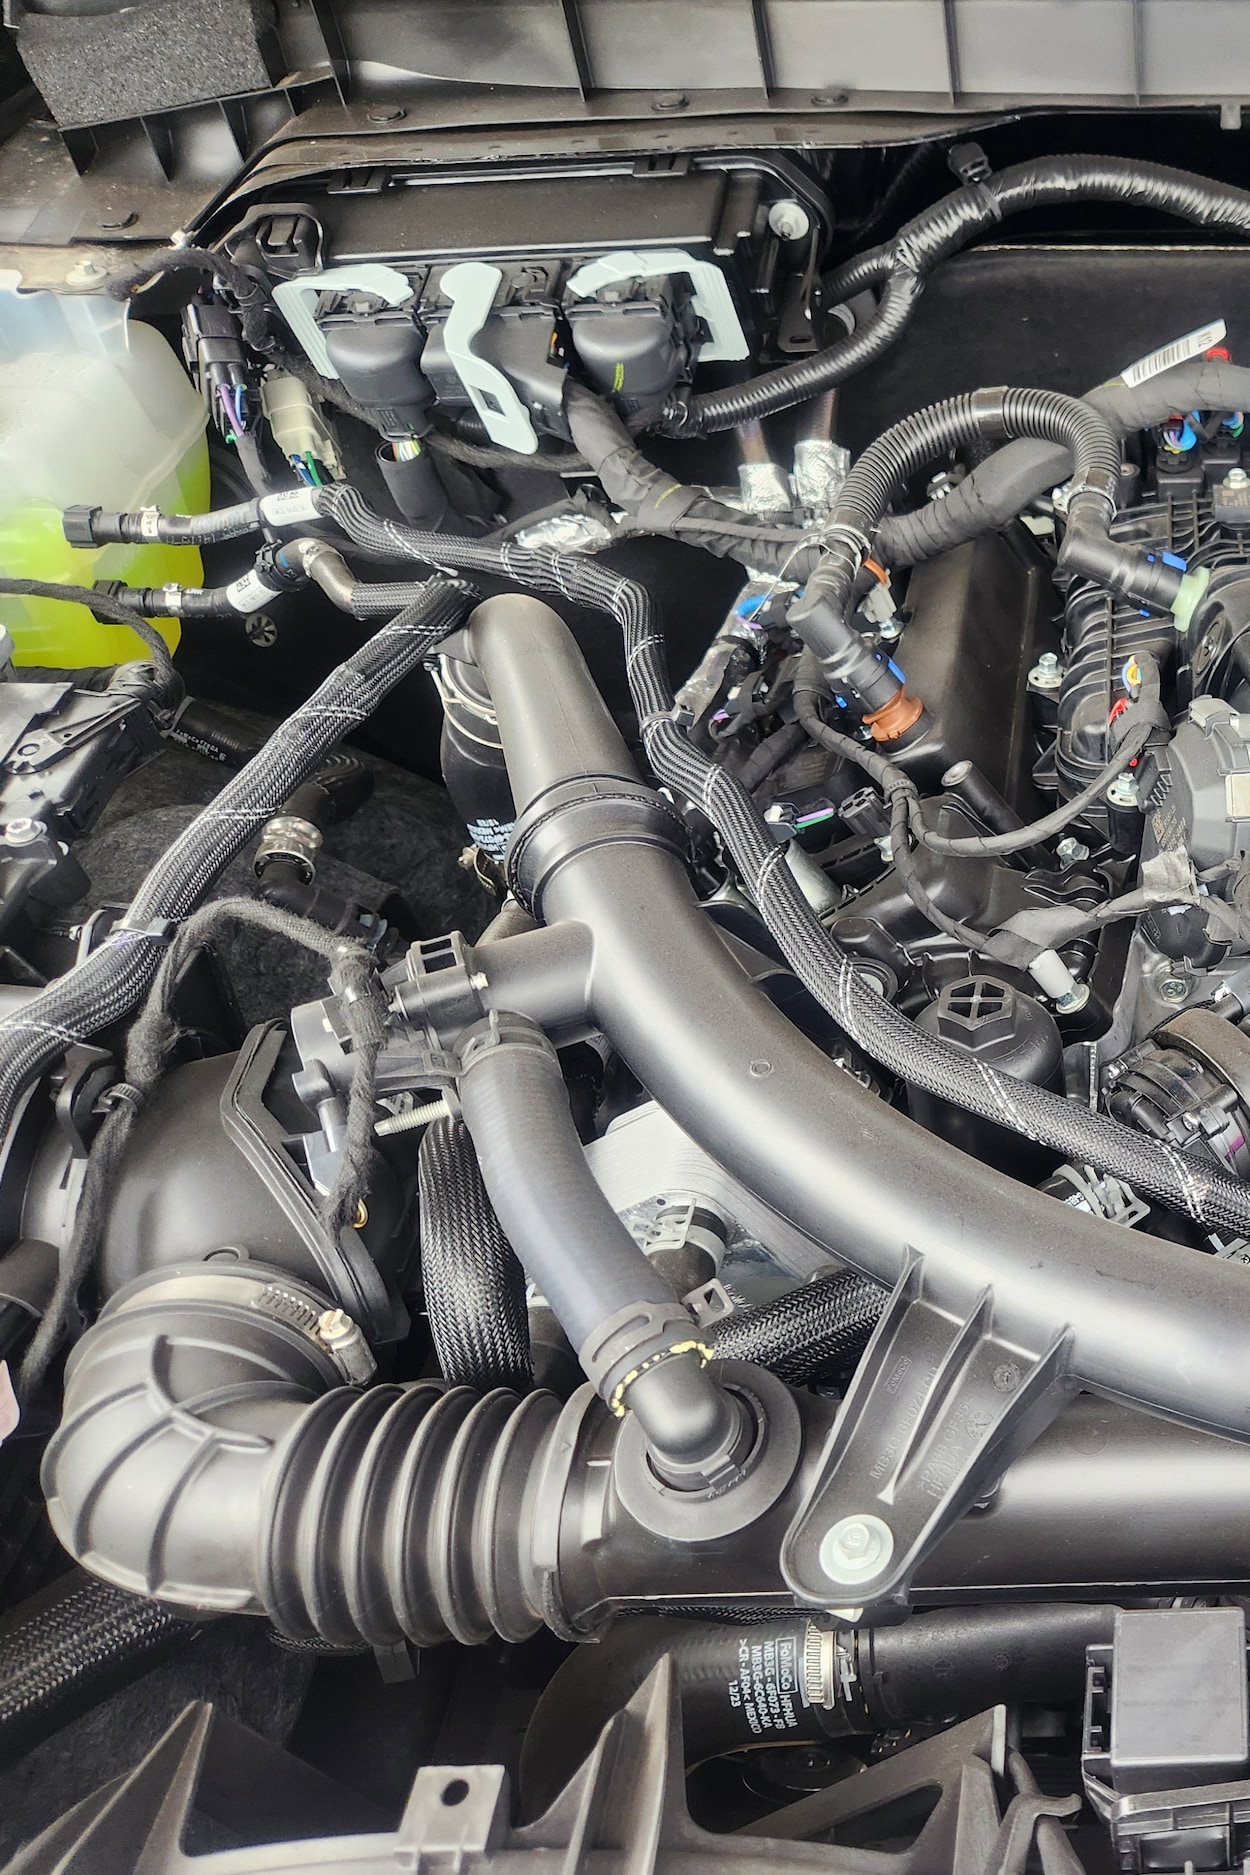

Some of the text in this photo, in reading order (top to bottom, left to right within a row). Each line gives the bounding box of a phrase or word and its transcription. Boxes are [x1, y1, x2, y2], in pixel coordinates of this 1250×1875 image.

[728, 1680, 742, 1708] 12/23
[780, 1641, 799, 1728] FoMoCo HFHUA
[744, 1702, 763, 1734] MEXICO
